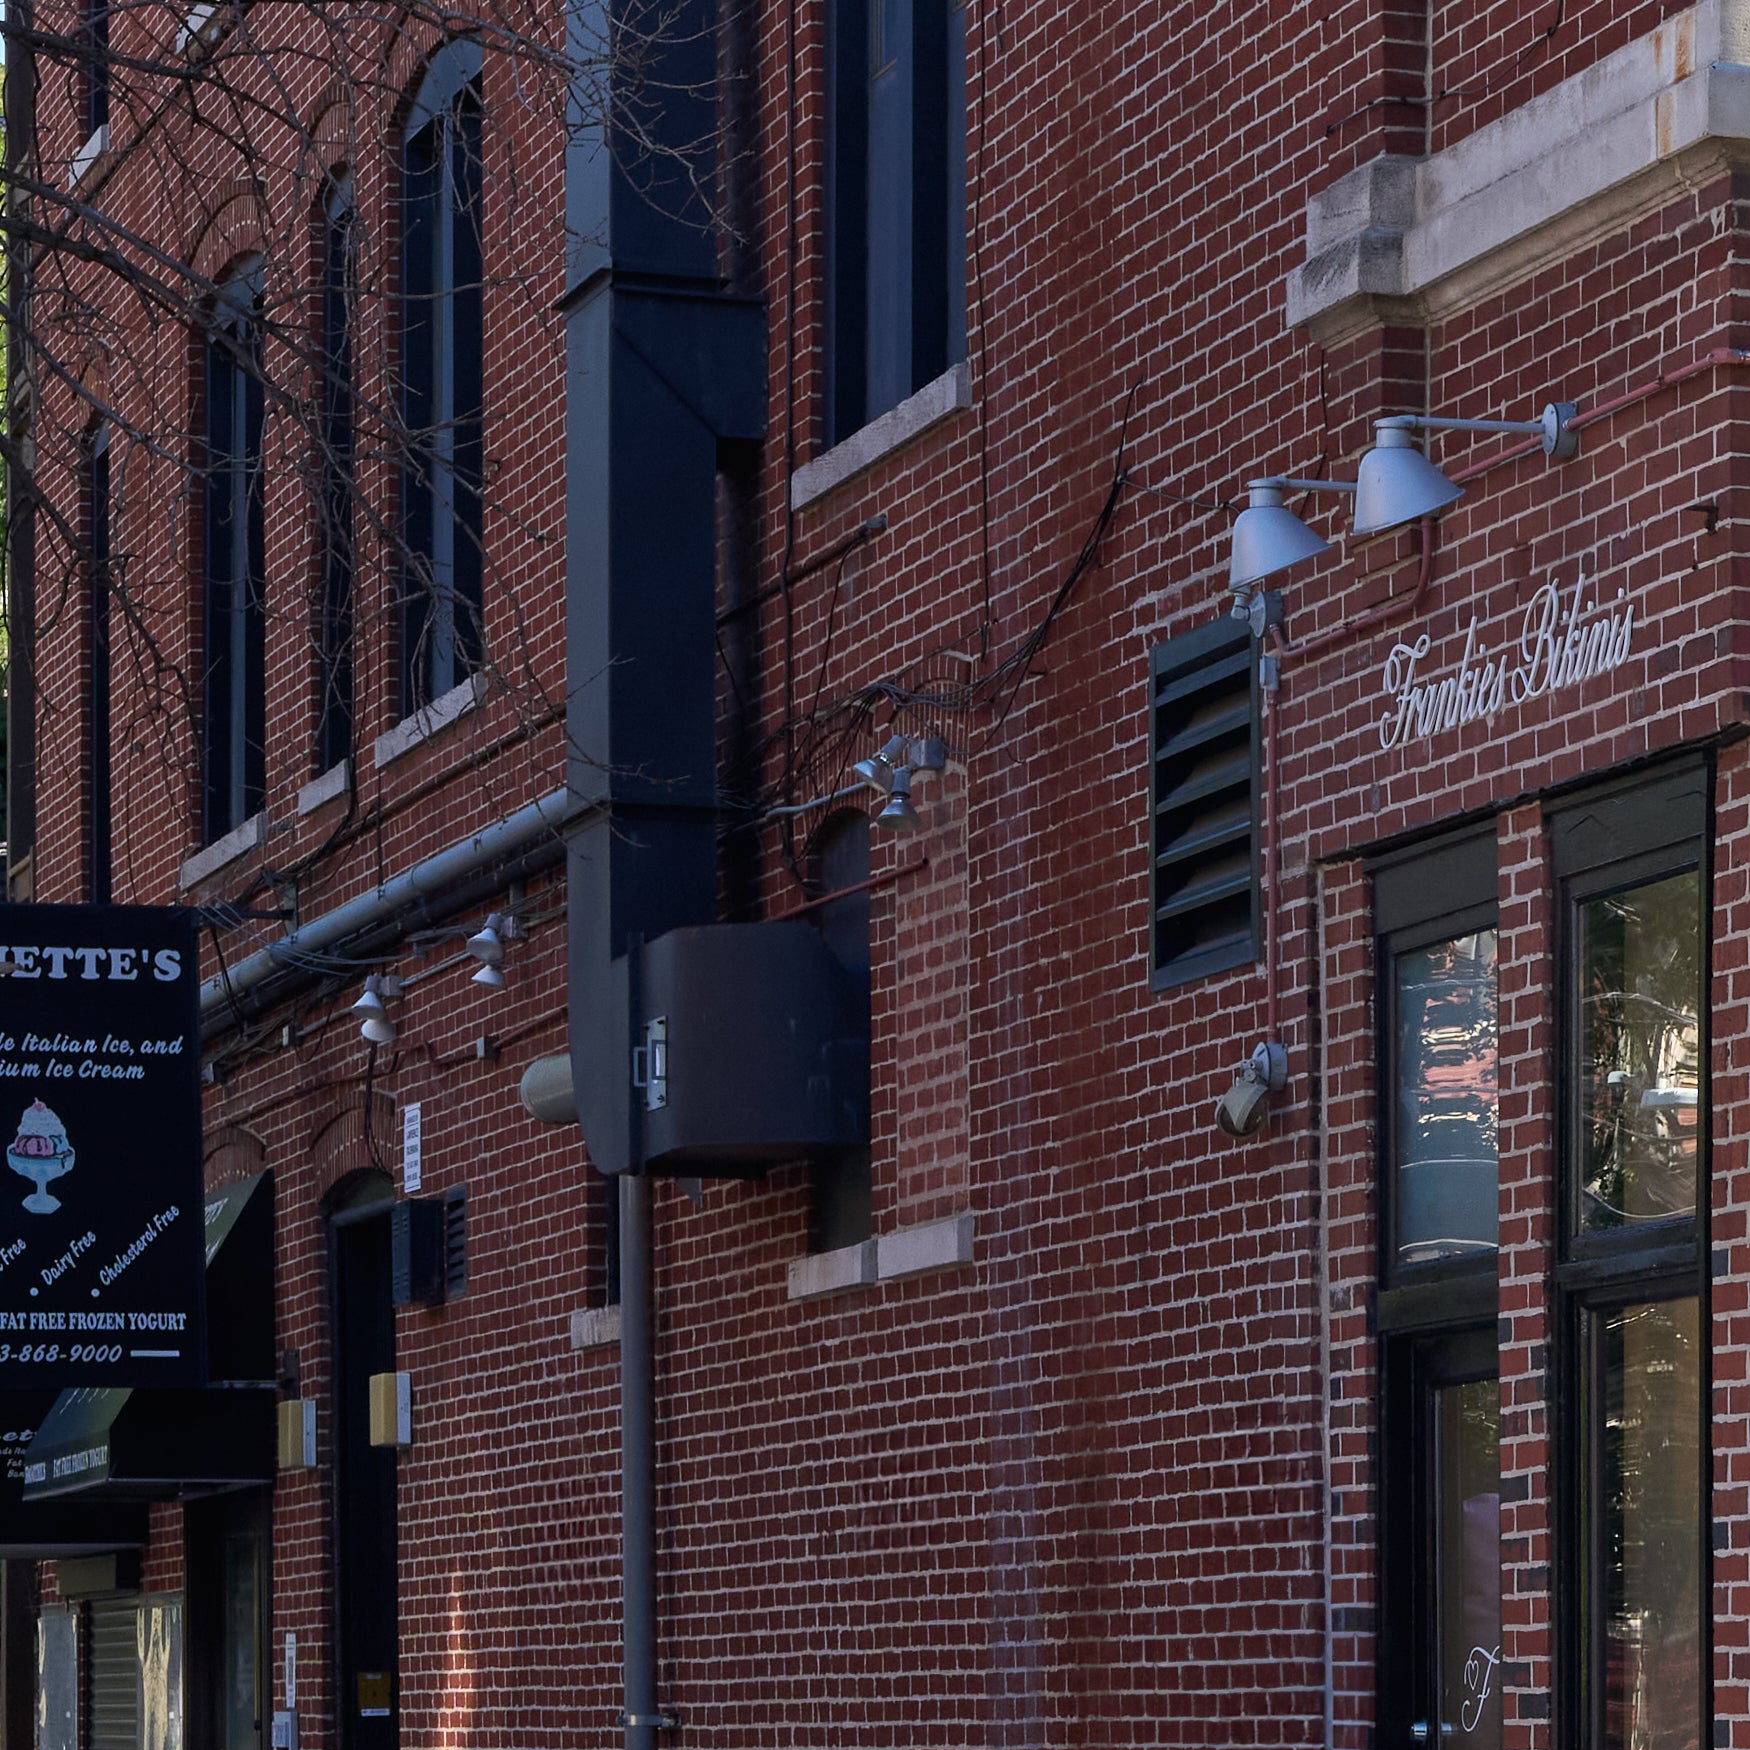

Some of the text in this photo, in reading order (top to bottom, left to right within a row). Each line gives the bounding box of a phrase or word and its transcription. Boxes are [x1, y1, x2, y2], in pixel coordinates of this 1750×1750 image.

[1379, 573, 1635, 749] Frankies Bikinis
[21, 1032, 98, 1053] Italian
[102, 1034, 135, 1056] Ice,
[140, 1036, 184, 1055] and
[45, 1058, 74, 1078] Ice
[78, 1059, 146, 1080] Cream
[41, 1231, 97, 1286] Dairy Free
[99, 1223, 158, 1286] Cholesterol
[153, 1205, 180, 1232] Free
[0, 1312, 187, 1331] FAT FREE FROZEN YOGURT
